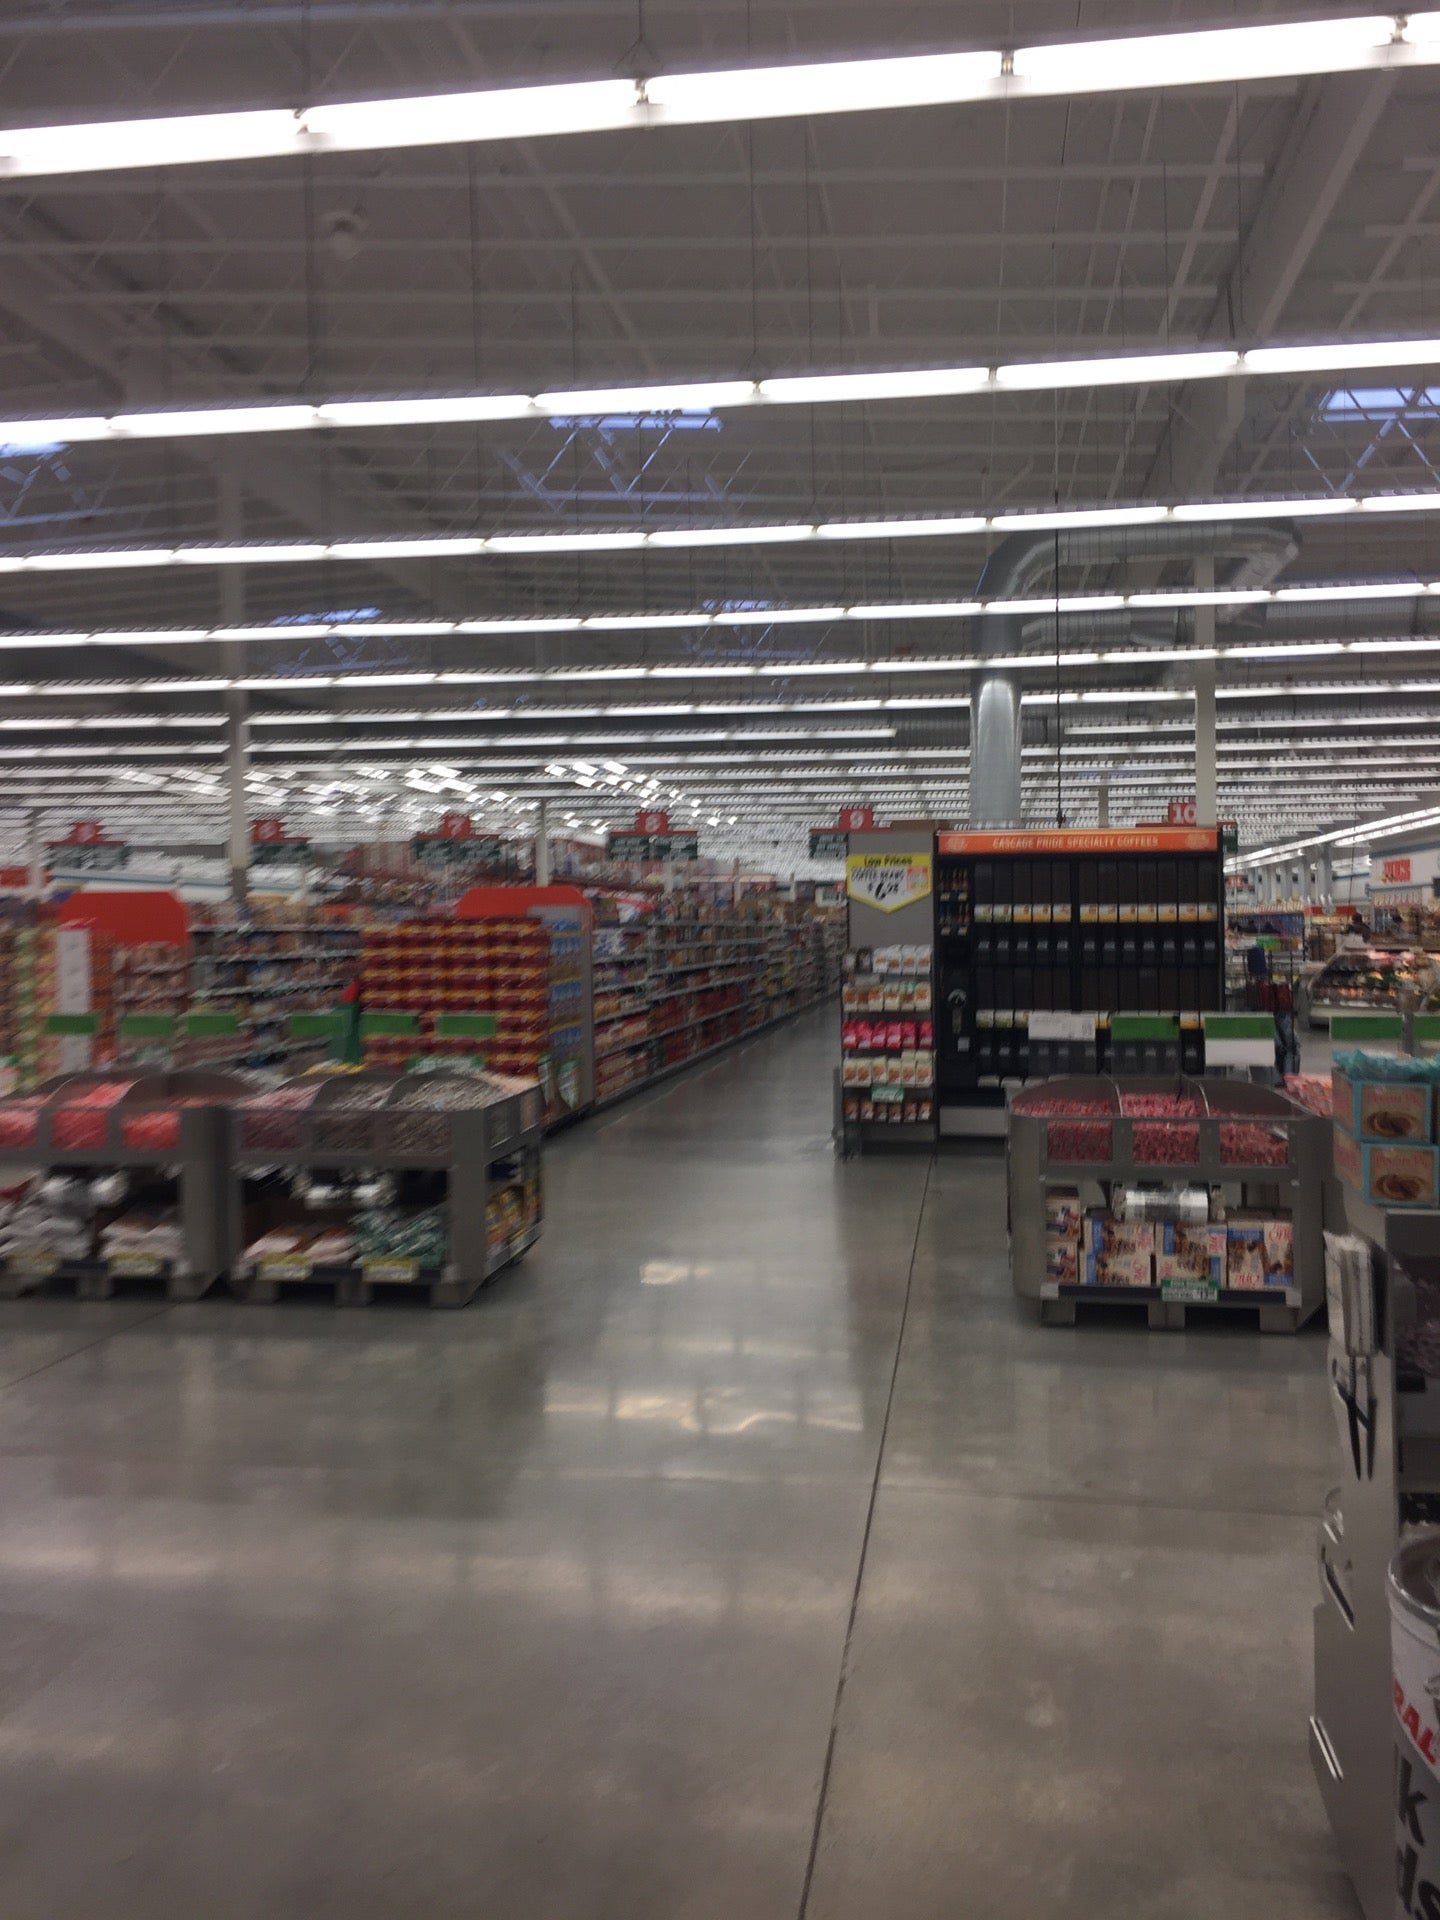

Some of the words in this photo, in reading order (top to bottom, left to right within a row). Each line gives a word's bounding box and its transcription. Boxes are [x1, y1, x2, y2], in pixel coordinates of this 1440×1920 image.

[1172, 803, 1197, 824] 10
[447, 817, 465, 836] 7
[1066, 836, 1114, 849] SPECIALTY
